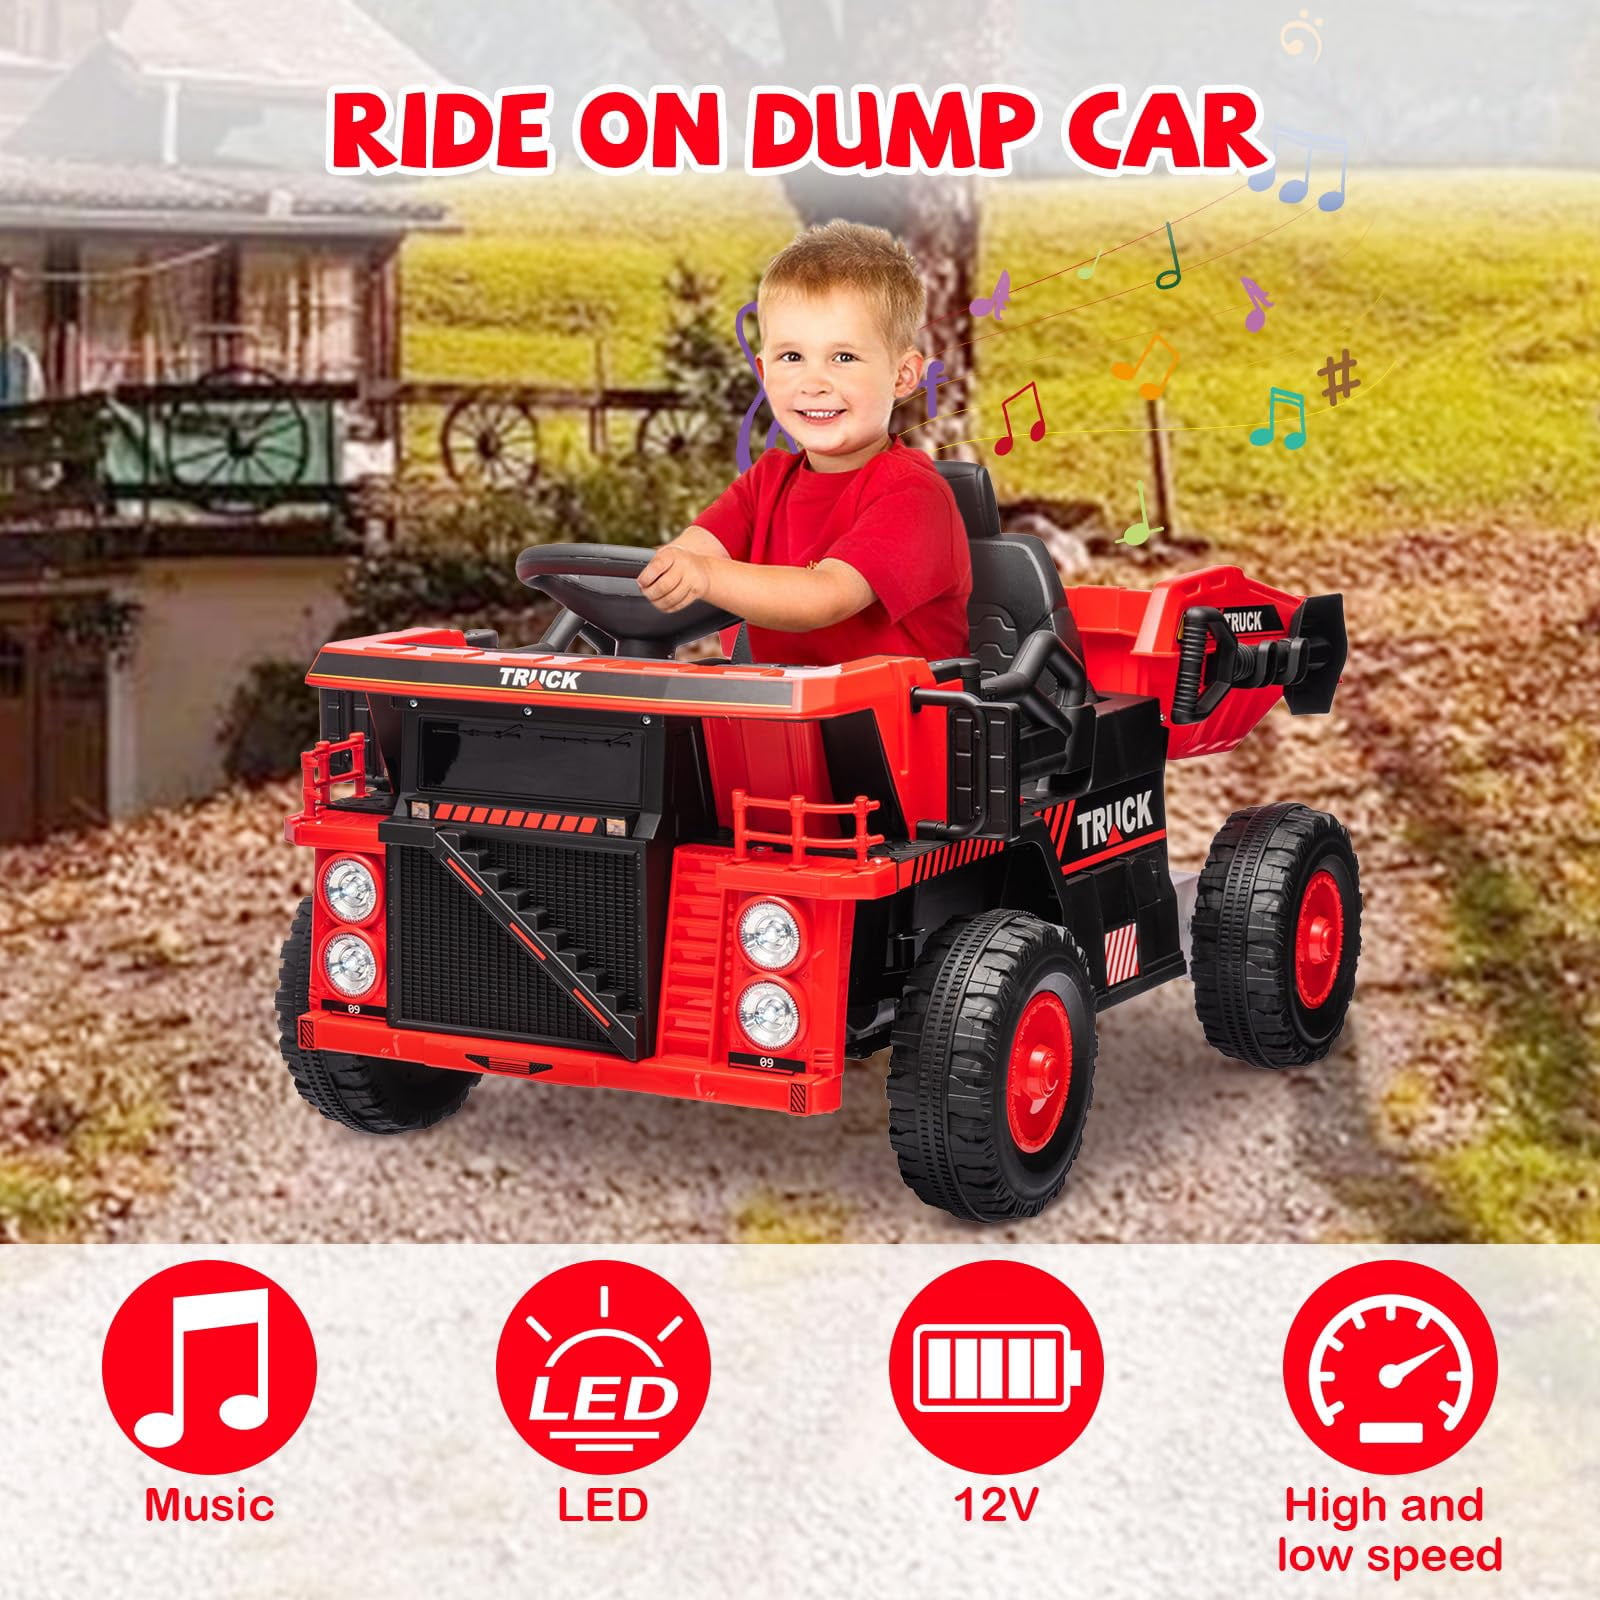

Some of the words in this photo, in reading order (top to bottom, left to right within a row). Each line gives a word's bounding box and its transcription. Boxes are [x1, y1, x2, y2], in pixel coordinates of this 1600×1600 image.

[499, 667, 582, 691] TRUCK
[1076, 789, 1154, 850] TRUCK
[347, 1004, 361, 1015] 09
[759, 1056, 775, 1068] 09
